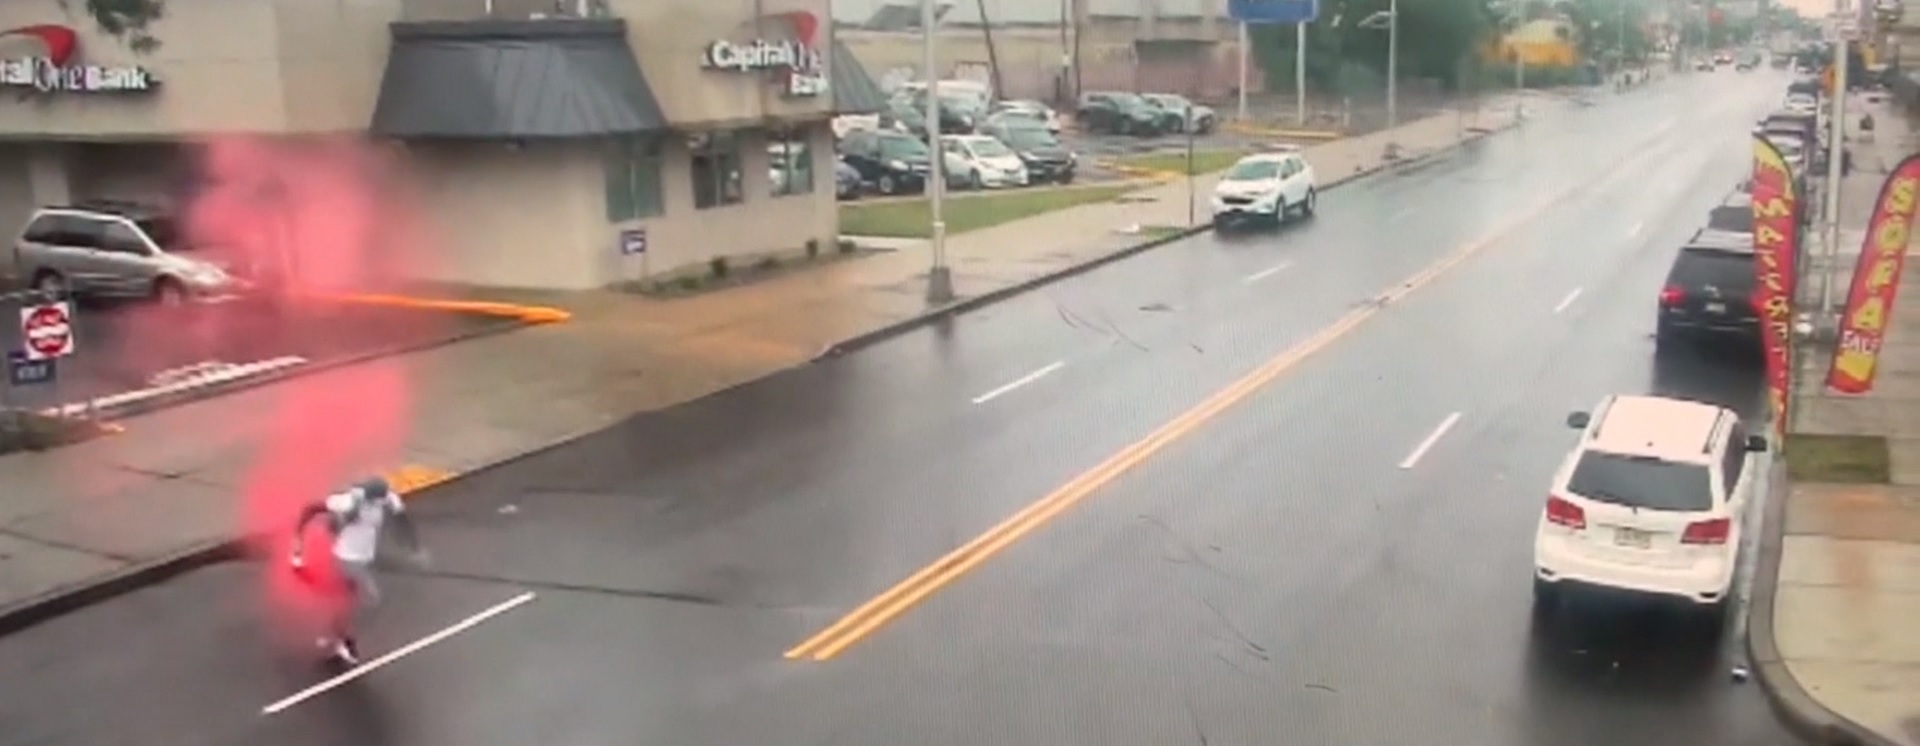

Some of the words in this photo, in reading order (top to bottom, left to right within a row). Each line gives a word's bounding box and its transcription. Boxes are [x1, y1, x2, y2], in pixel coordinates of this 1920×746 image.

[712, 39, 792, 71] Capital
[85, 65, 147, 91] Bank
[1854, 177, 1917, 331] SOFA
